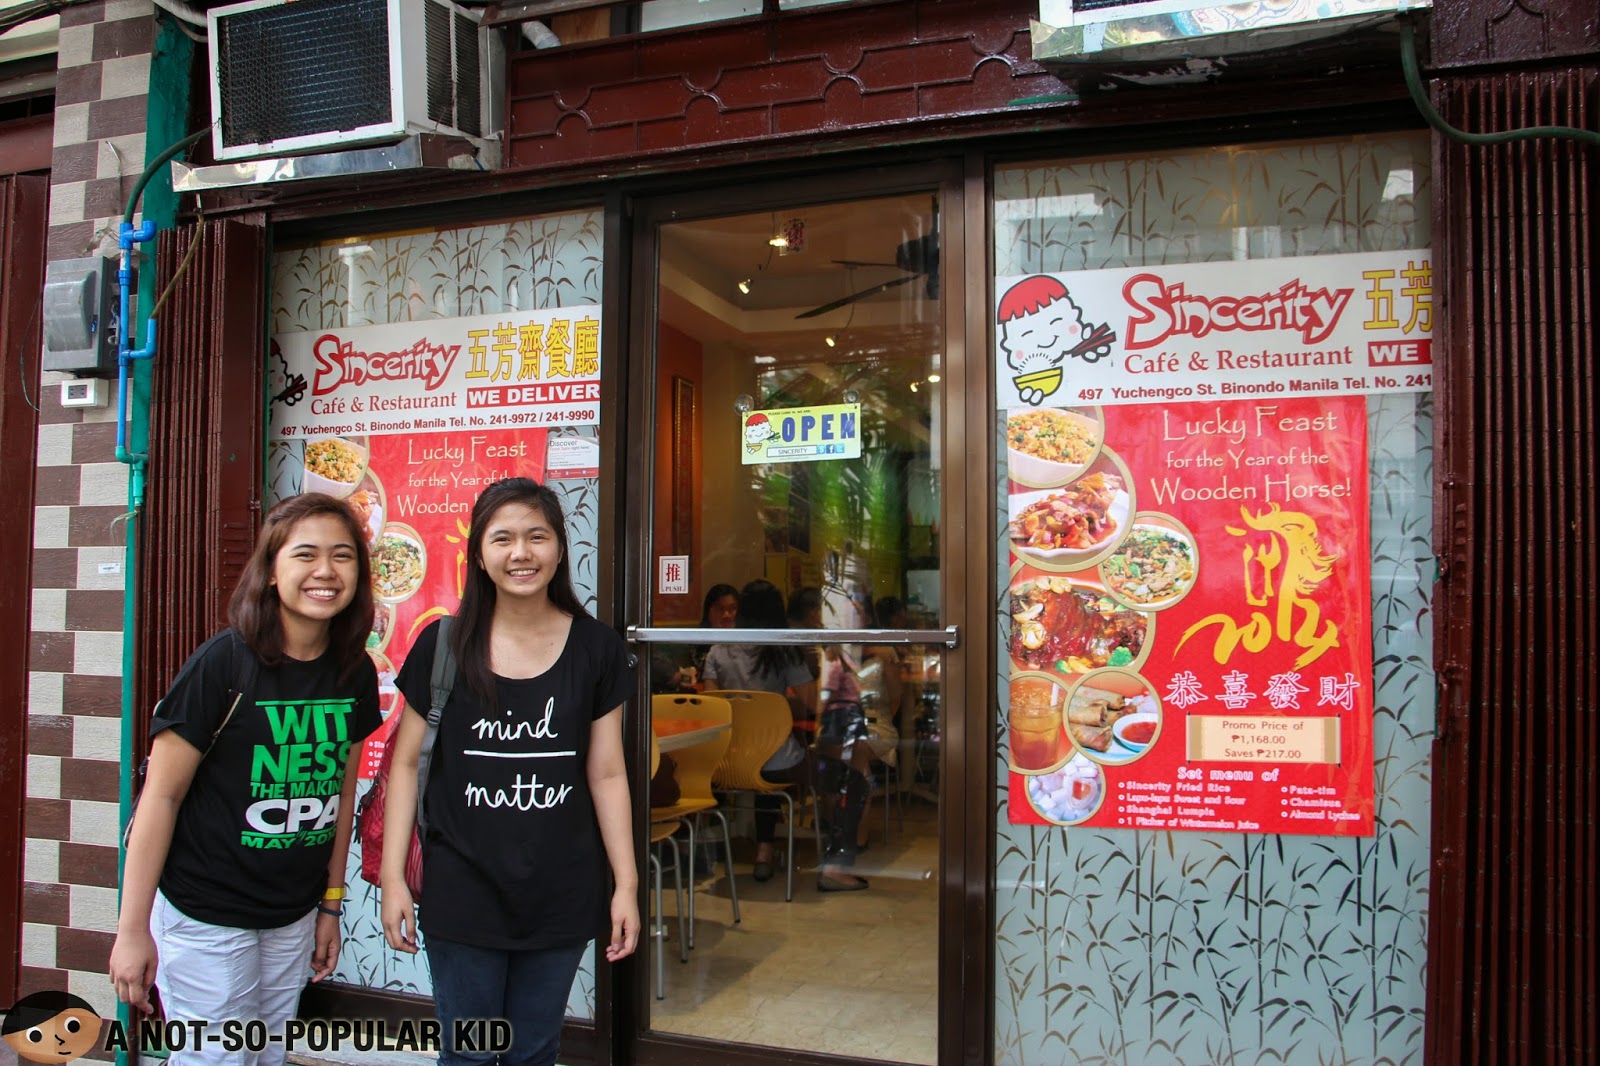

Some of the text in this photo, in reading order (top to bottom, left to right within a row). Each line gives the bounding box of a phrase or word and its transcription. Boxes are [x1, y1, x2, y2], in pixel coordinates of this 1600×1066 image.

[1122, 273, 1355, 350] Sincerity
[312, 334, 462, 396] Sincerity
[1124, 346, 1353, 374] Café & Restaurant
[1370, 344, 1418, 363] WE
[468, 383, 600, 406] WE DELIVER
[1078, 388, 1103, 400] 497
[1111, 386, 1193, 399] Yuchengco
[1197, 383, 1217, 395] St.
[1221, 381, 1285, 394] Binondo
[1289, 378, 1339, 391] Manila
[1343, 376, 1370, 389] Tel.
[1375, 376, 1400, 388] No.
[311, 392, 457, 415] Café & Restaurant
[281, 410, 595, 436] 497 Yuchengco St. Binondo Manila Tel. No. 241-9972 / 241-9990
[782, 412, 855, 442] OPEN
[1163, 405, 1337, 445] Lucky Feast
[407, 435, 527, 467] Lucky Feast
[778, 447, 808, 455] SINCERITY
[1165, 447, 1330, 469] for the Year of the
[408, 472, 426, 487] for
[428, 471, 447, 487] the
[450, 471, 481, 488] Year
[483, 470, 497, 485] of
[1150, 473, 1352, 505] Wooden Horse!
[397, 493, 469, 517] Wooden
[665, 563, 681, 582] 推
[1162, 670, 1360, 711] 恭喜發財
[265, 704, 352, 744] WIT
[471, 696, 559, 740] mind
[1222, 720, 1304, 730] Promo Price of
[251, 741, 352, 783] NESS
[1224, 748, 1254, 758] Saves
[1177, 766, 1279, 781] Set menu of
[250, 780, 343, 799] THE MAKIN
[465, 773, 574, 811] matter
[1126, 781, 1231, 793] Sincerity Fried Rice
[1289, 785, 1336, 795] Pata-tim
[1126, 804, 1215, 817] Shanghai Lumpia
[1173, 794, 1201, 804] Sweet
[1204, 795, 1222, 804] and
[1225, 795, 1246, 805] Sour
[245, 794, 340, 834] CPA
[1127, 817, 1132, 825] 1
[1167, 818, 1178, 827] of
[1289, 809, 1325, 819] Almond
[240, 836, 296, 850] MAY
